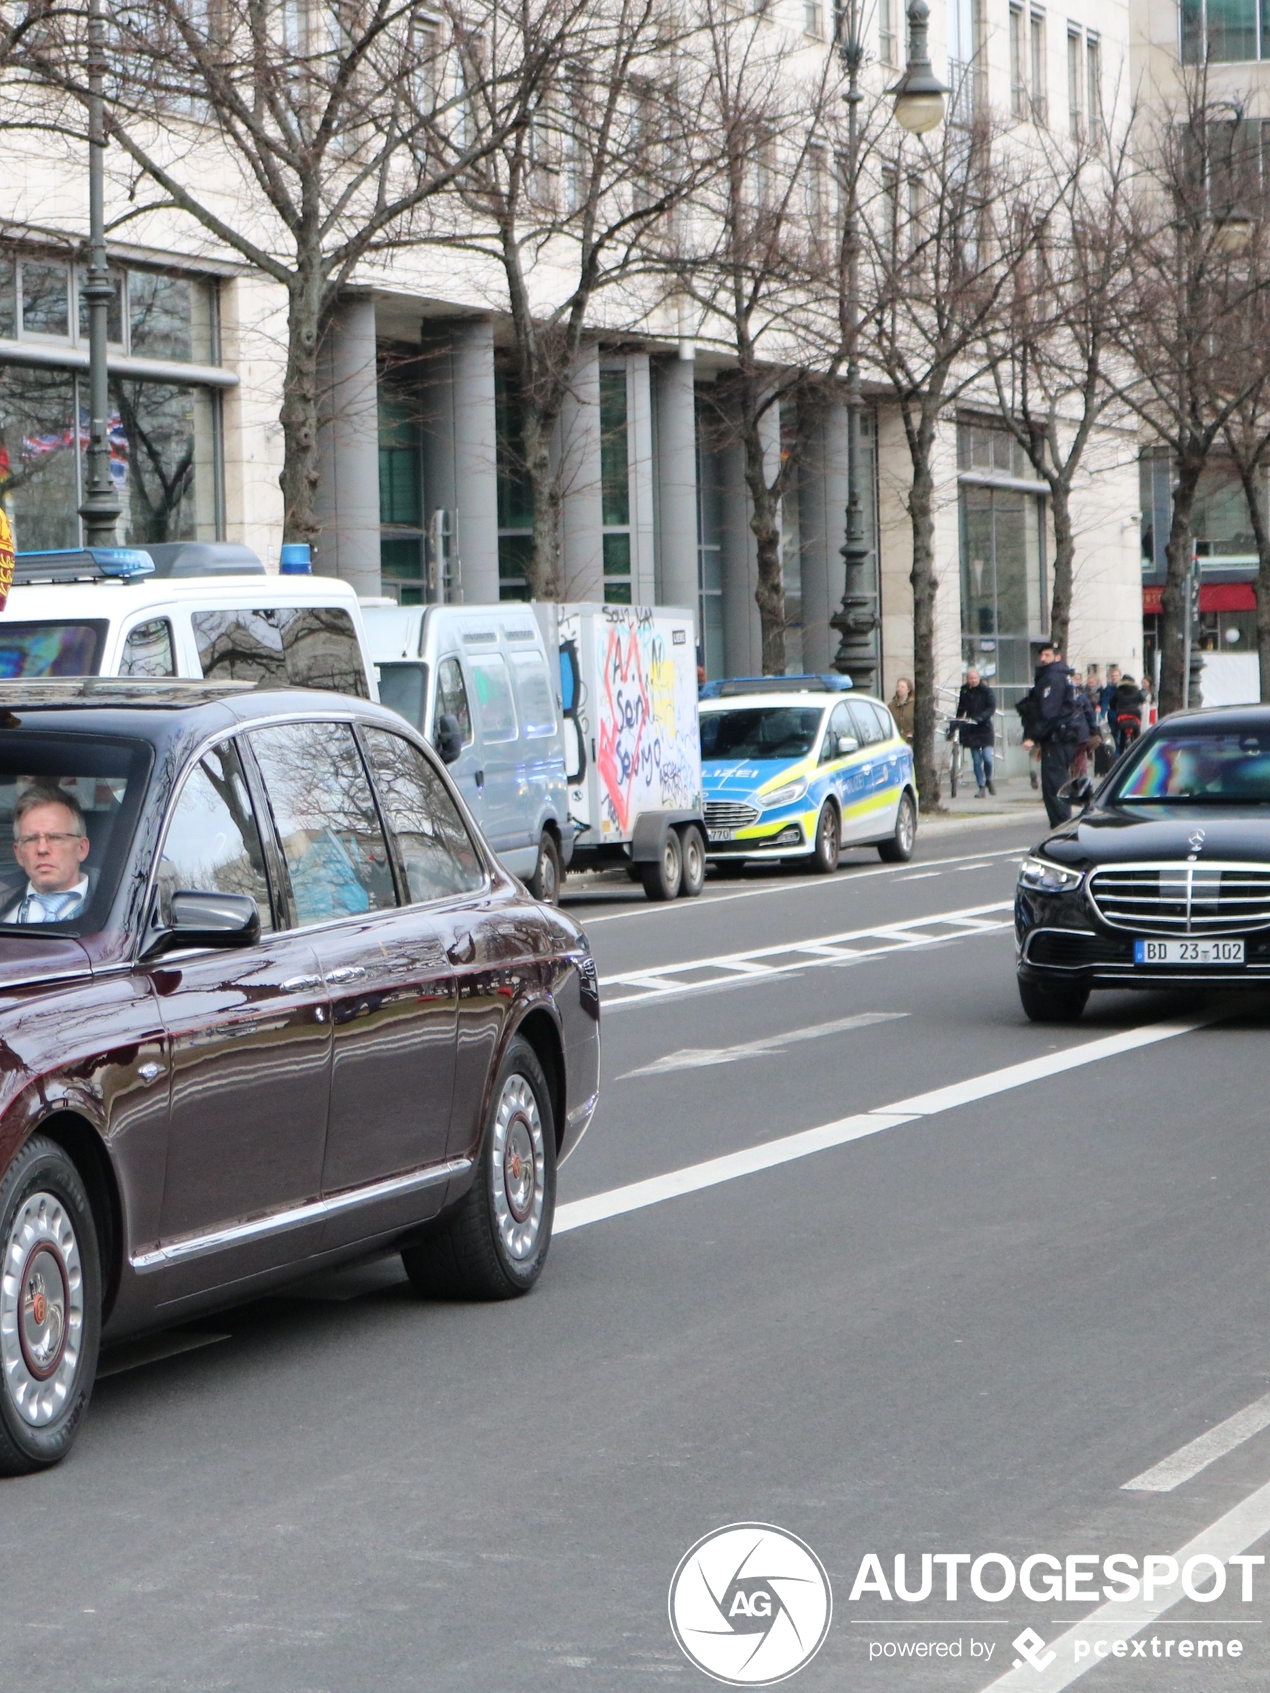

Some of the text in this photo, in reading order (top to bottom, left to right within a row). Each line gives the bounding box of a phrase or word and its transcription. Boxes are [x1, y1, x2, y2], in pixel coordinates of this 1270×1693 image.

[701, 769, 759, 779] LIZEI
[1147, 943, 1167, 960] BD
[1179, 943, 1242, 960] 23-102
